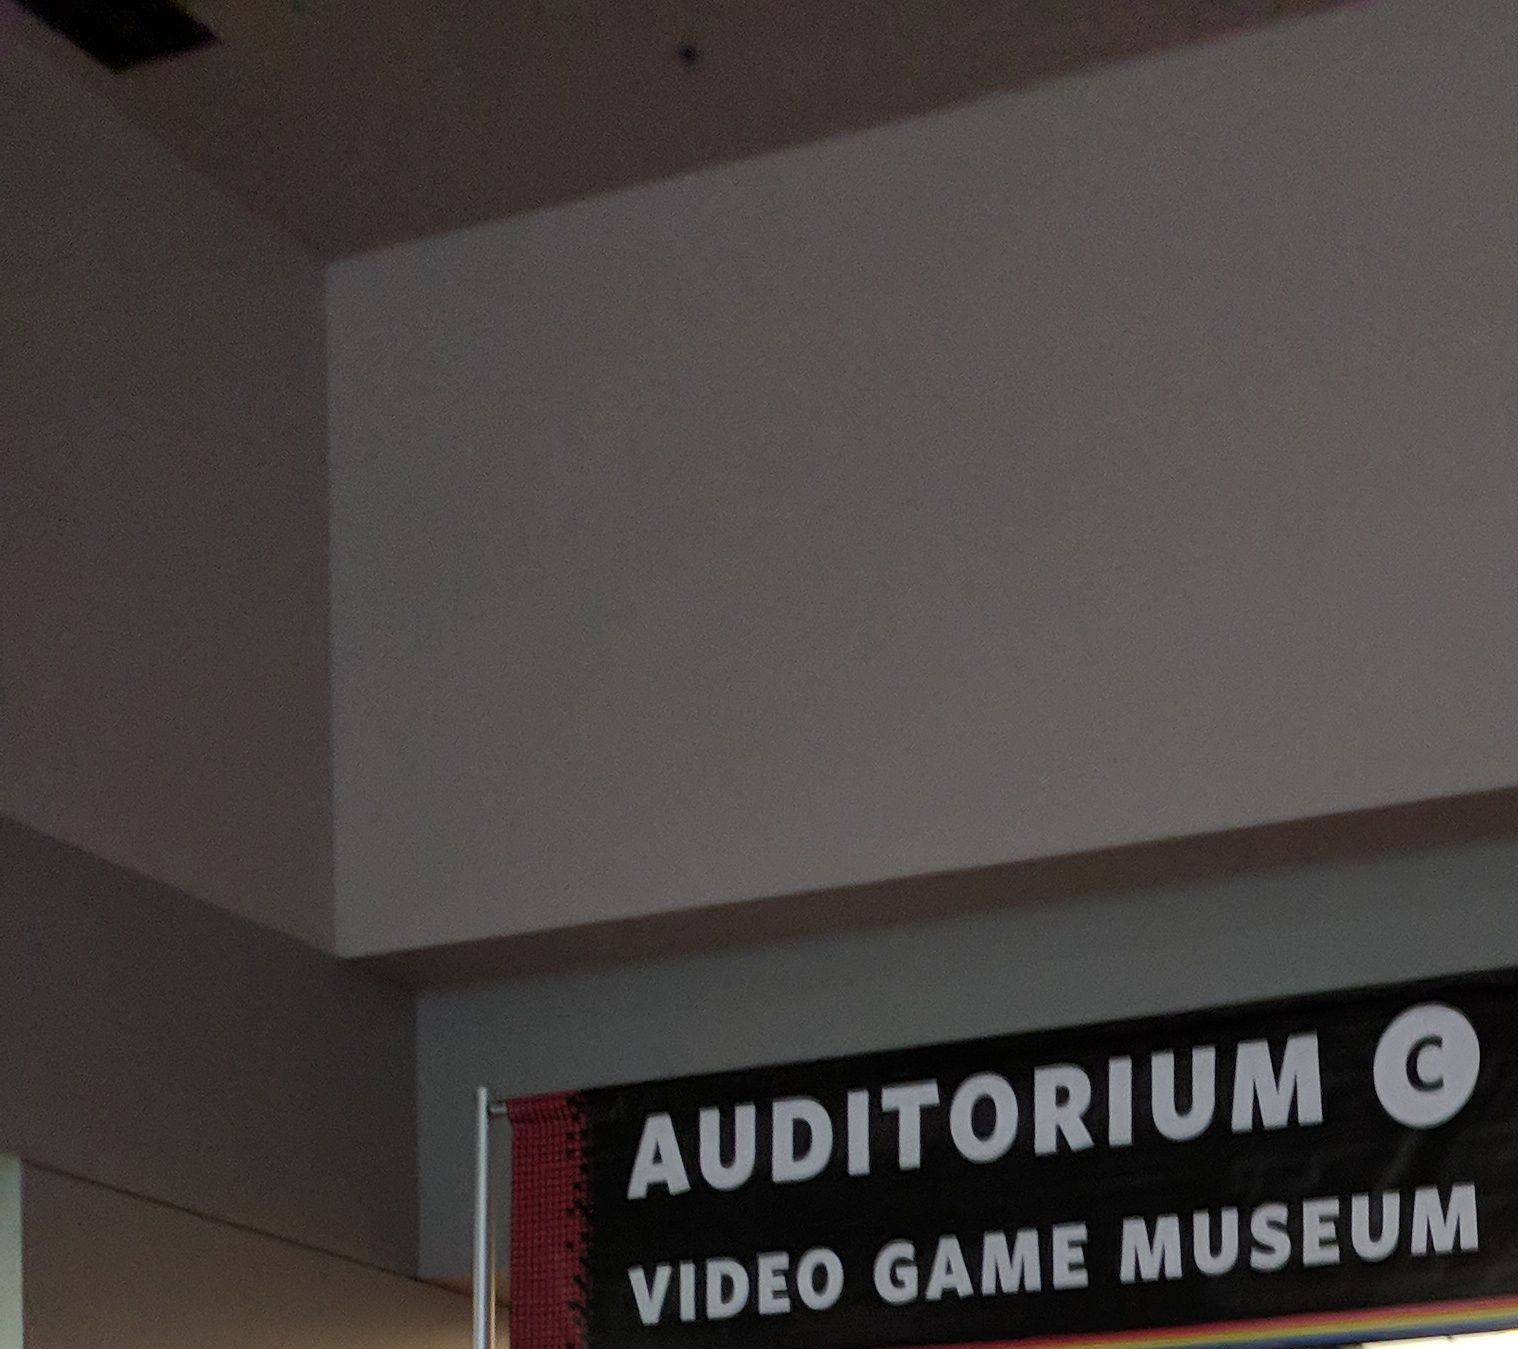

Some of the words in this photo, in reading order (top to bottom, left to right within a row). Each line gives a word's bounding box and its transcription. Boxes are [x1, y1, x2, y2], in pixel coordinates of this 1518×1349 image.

[628, 1032, 1324, 1199] AUDITORIUM
[1404, 1034, 1445, 1093] C
[628, 1247, 845, 1325] VIDEO
[874, 1224, 1089, 1304] GAME
[1120, 1183, 1479, 1283] MUSEUM
